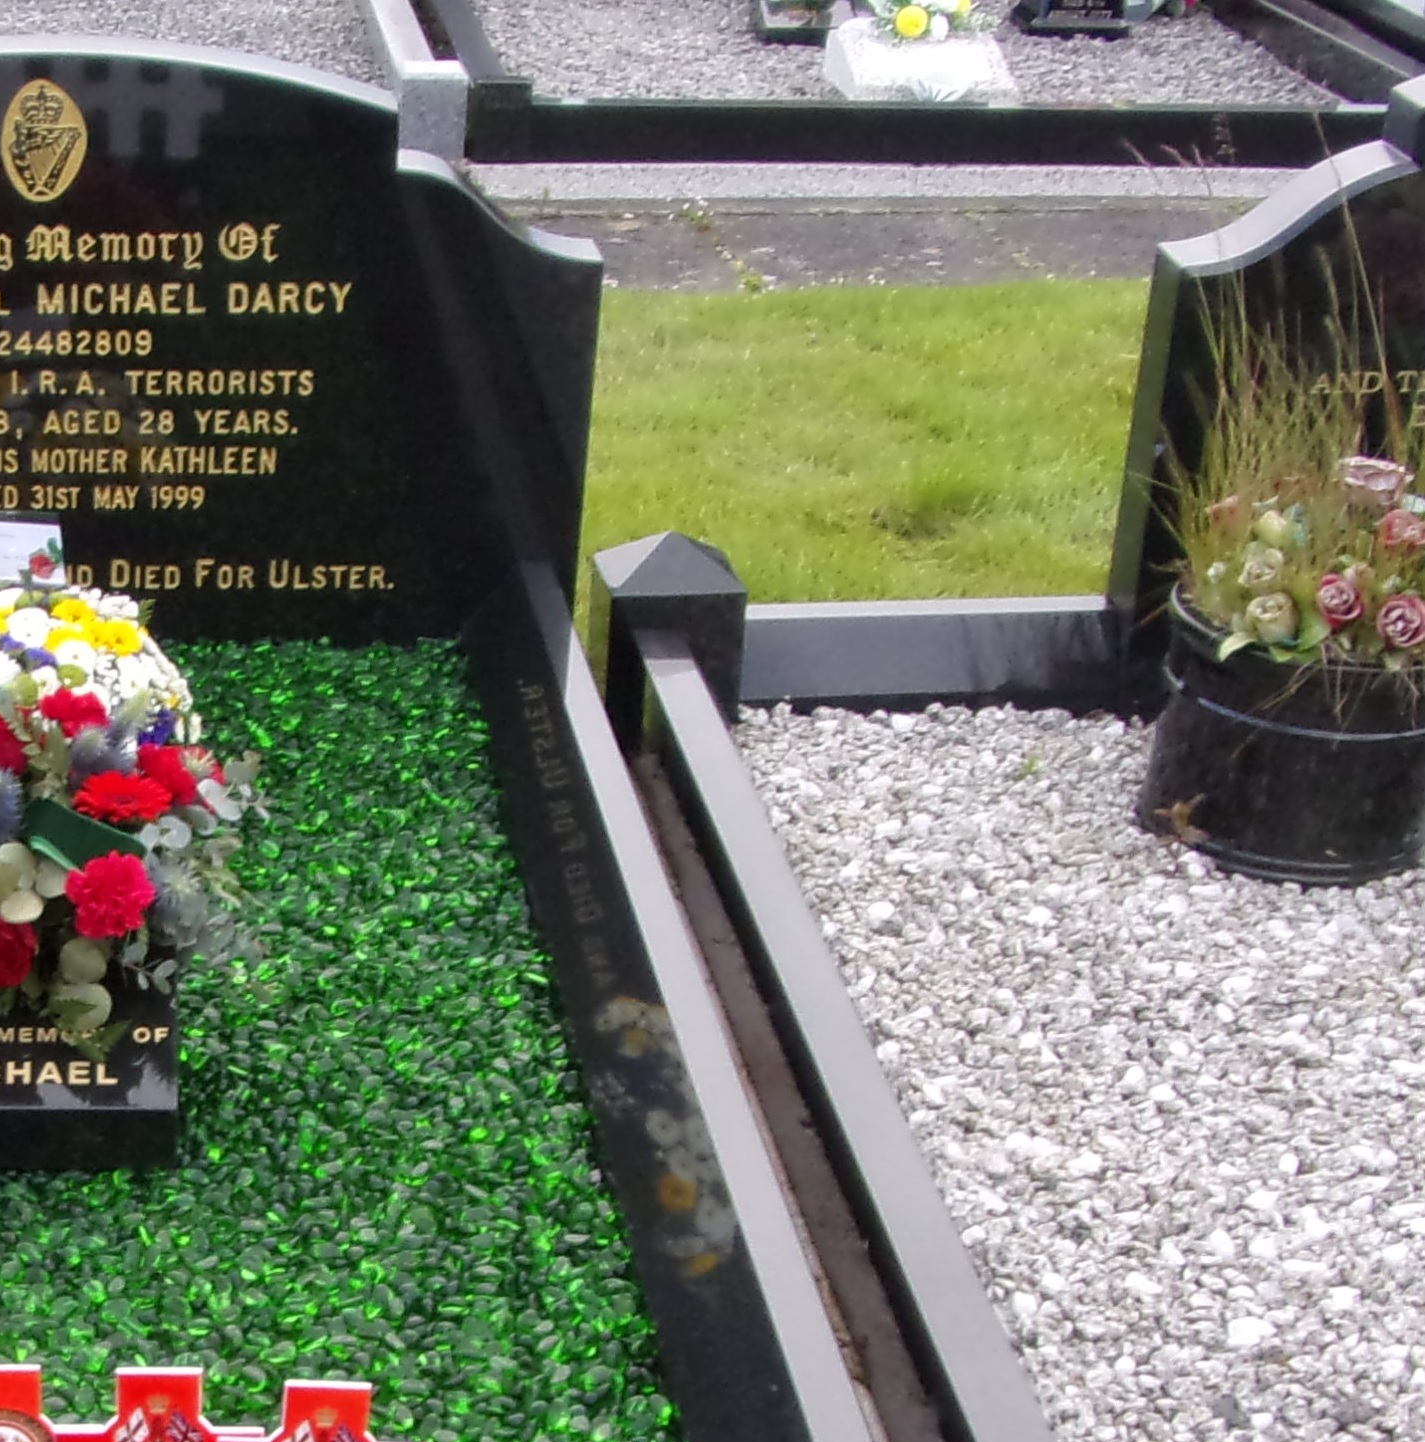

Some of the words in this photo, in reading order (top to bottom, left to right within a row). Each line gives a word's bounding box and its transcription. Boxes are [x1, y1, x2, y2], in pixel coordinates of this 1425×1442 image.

[26, 225, 202, 270] Memory
[219, 223, 279, 263] Of
[37, 283, 205, 314] MICHAEL
[228, 282, 351, 314] DARCY
[125, 370, 313, 396] TERRORISTS
[44, 410, 120, 434] AGED
[139, 411, 173, 434] 28
[194, 410, 297, 434] YEARS.
[32, 449, 127, 473] MOTHER
[141, 447, 276, 474] KATHLEEN
[31, 485, 80, 509] 31ST
[94, 486, 139, 509] MAY
[151, 486, 204, 509] 1999
[110, 560, 180, 588] DIED
[196, 559, 254, 589] FOR
[269, 560, 394, 589] ULSTER.
[133, 1028, 168, 1043] OF
